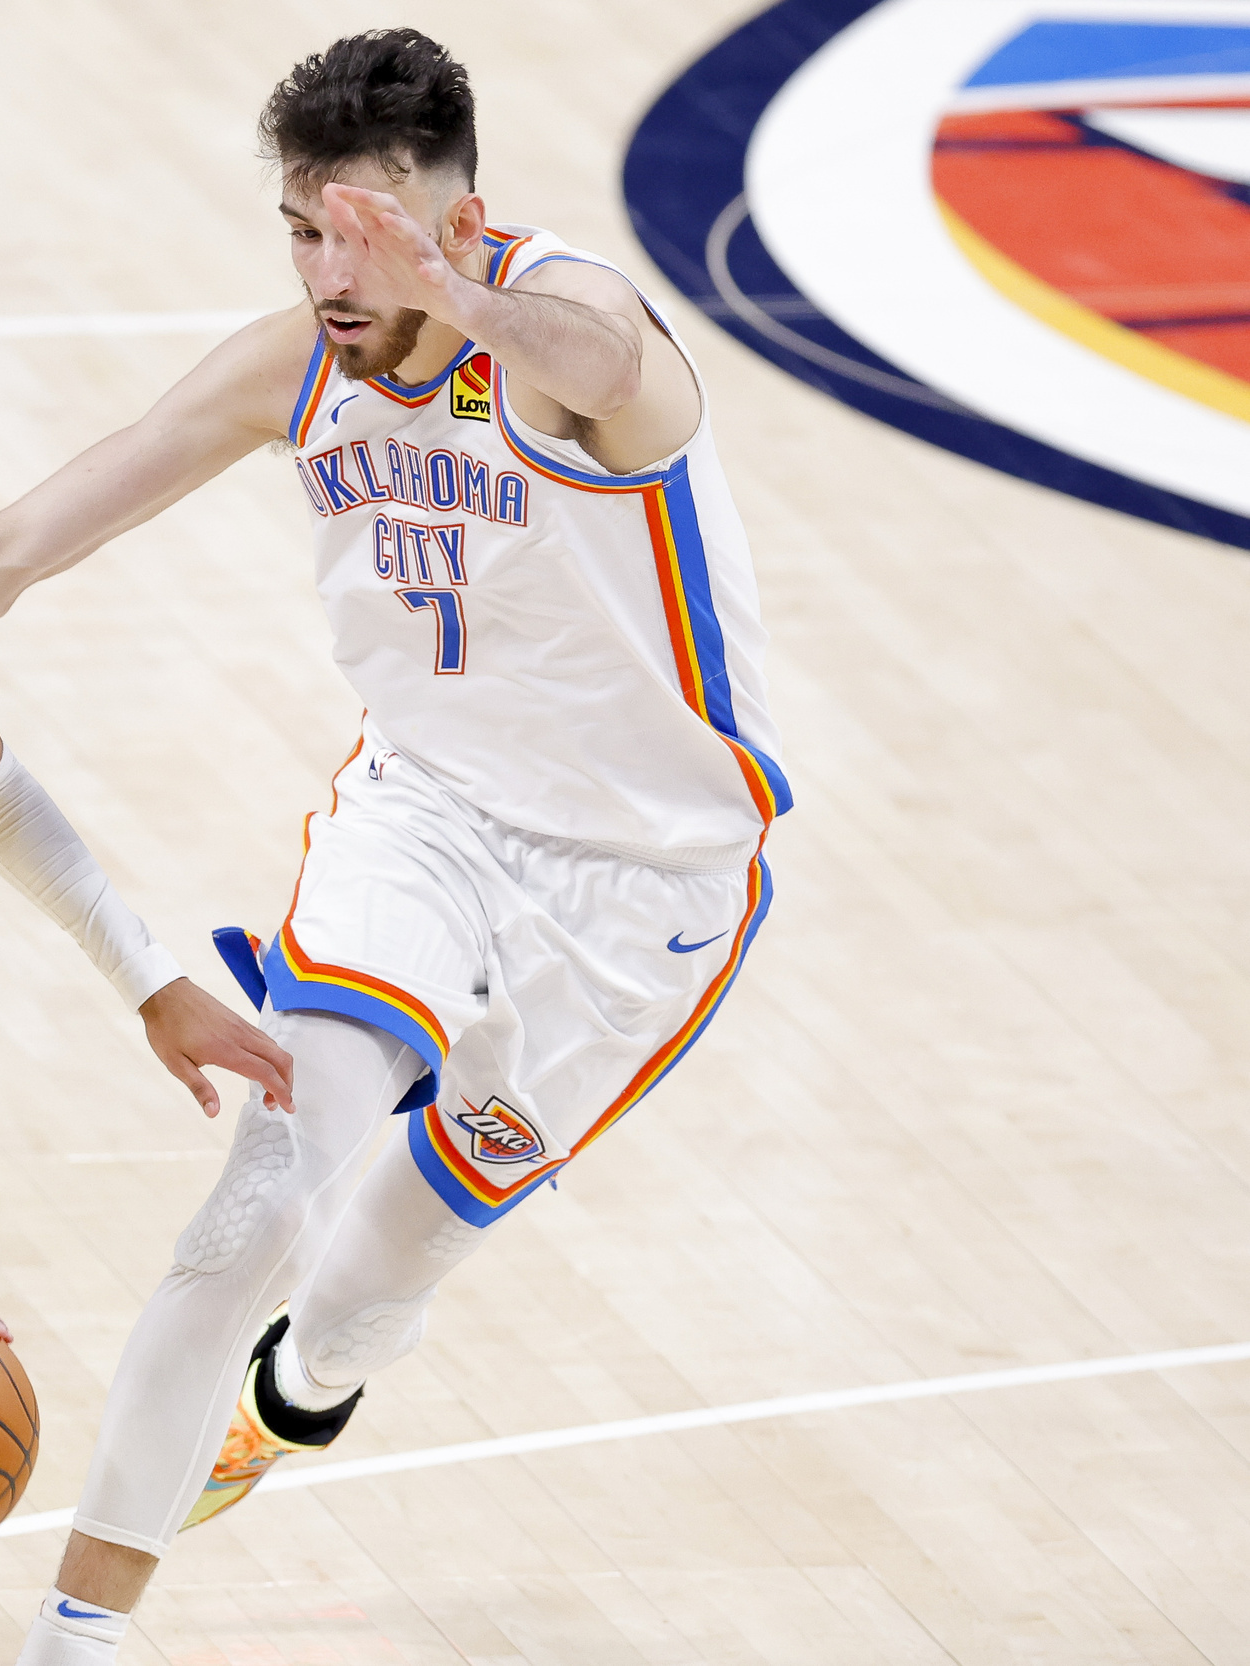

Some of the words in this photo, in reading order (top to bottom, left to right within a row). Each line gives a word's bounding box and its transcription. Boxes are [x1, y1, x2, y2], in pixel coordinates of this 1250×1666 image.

[295, 438, 528, 527] OKLAHOMA
[374, 514, 468, 585] CITY
[395, 588, 467, 675] 7
[457, 1113, 534, 1150] OKC
